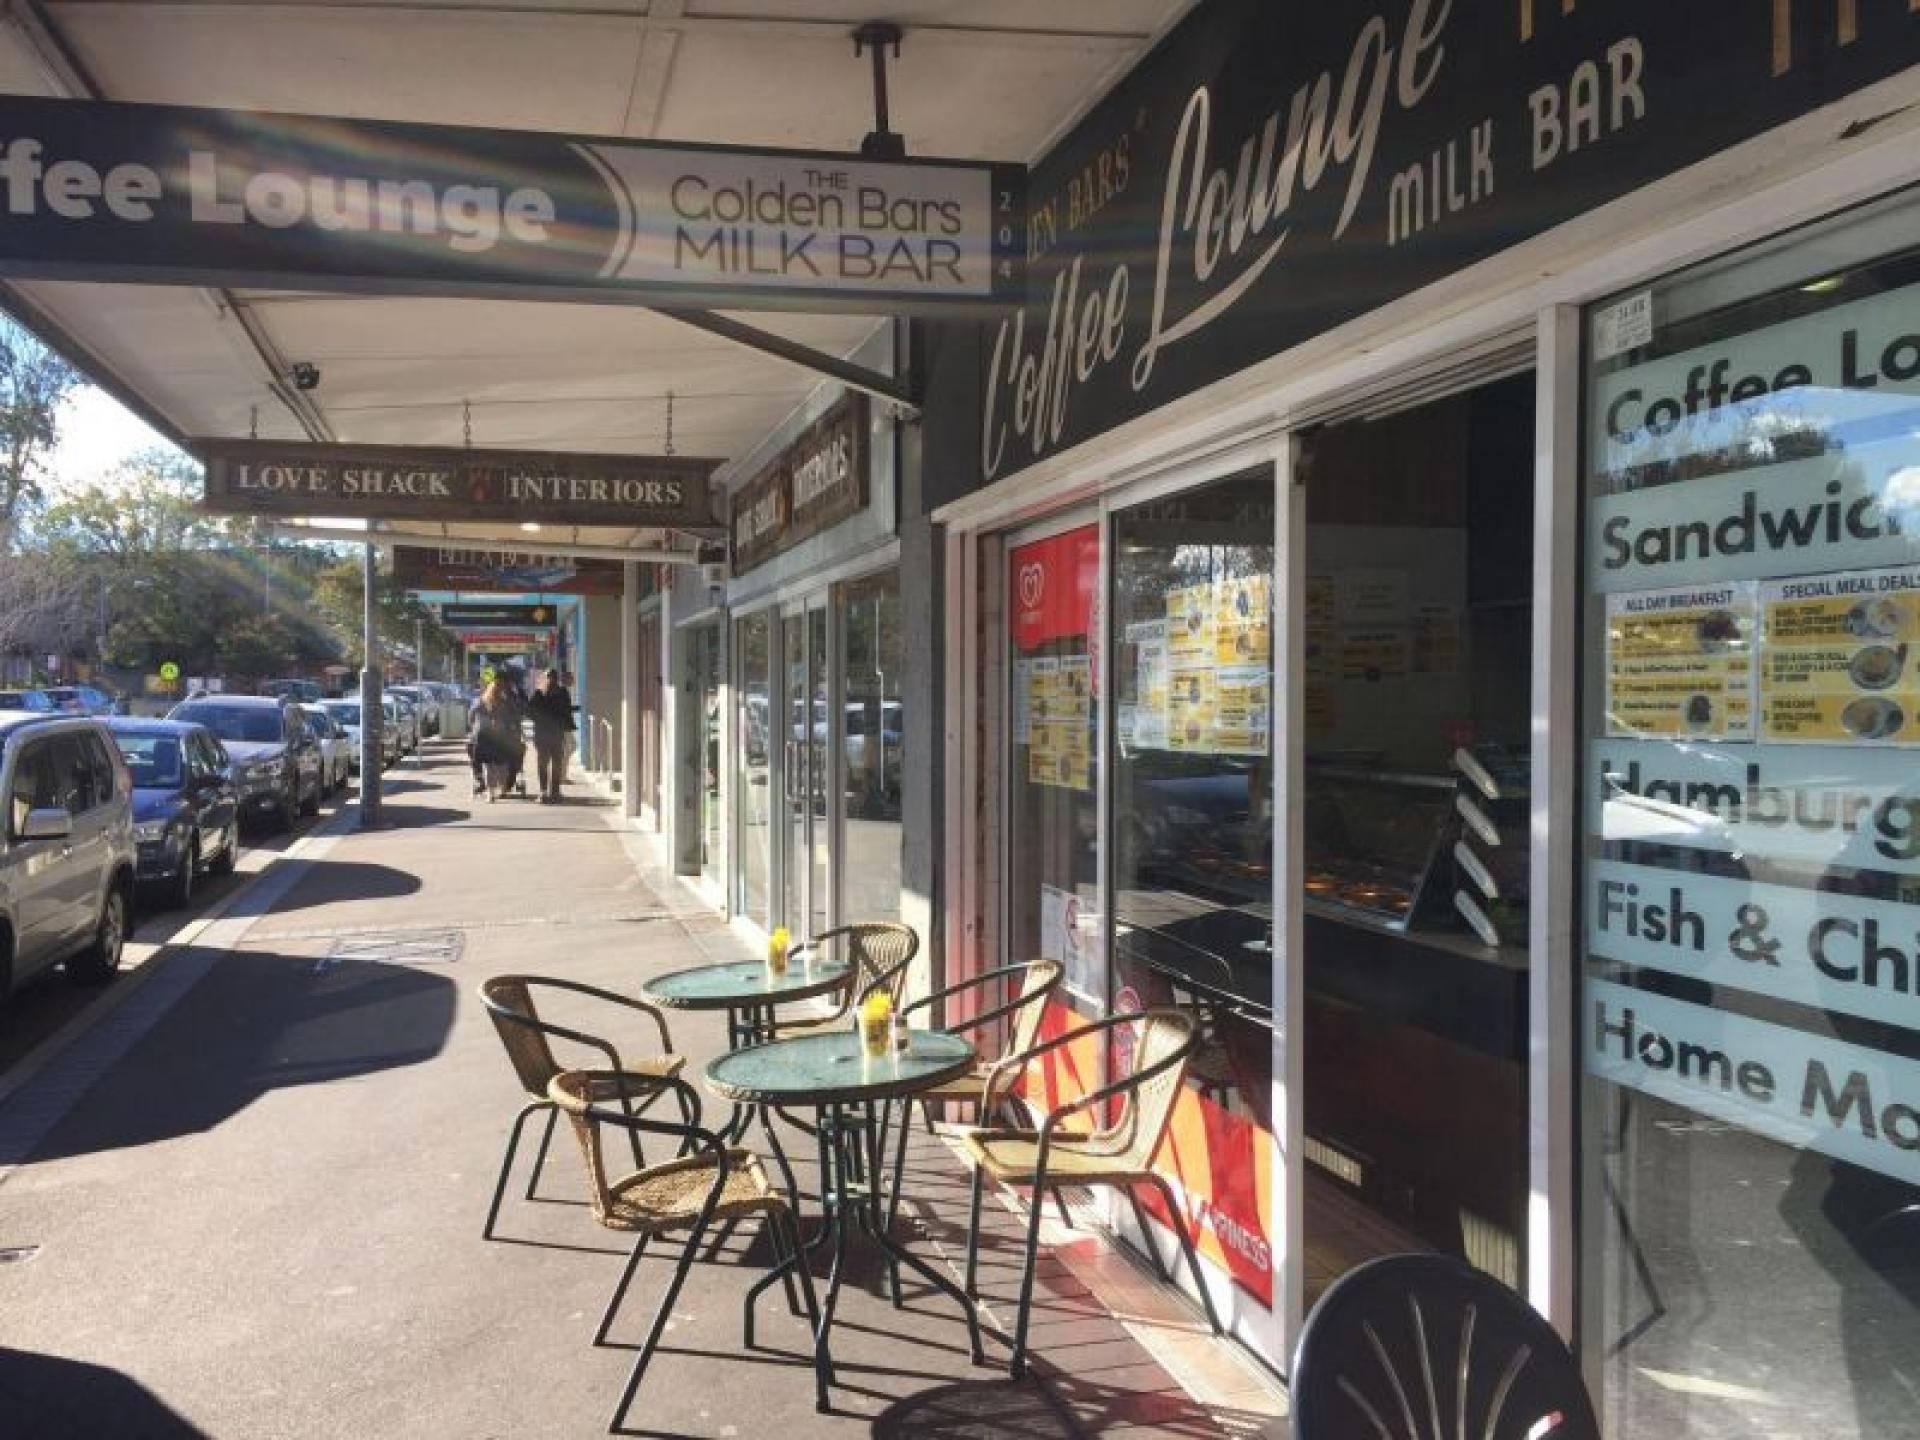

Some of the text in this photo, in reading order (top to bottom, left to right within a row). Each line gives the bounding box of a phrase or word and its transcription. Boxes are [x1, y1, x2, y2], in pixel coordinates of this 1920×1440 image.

[803, 170, 849, 190] THE
[1388, 119, 1494, 247] MILK
[1529, 36, 1645, 172] BAR
[0, 138, 556, 252] fee Lounge
[857, 188, 962, 234] Bars
[674, 225, 965, 284] MILK BAR
[984, 0, 1453, 481] Coffee Lounge
[239, 465, 682, 503] LOVE SHACK INTERIORS
[1603, 480, 1901, 569] Sandwic
[1598, 880, 1706, 951] Fish
[1728, 902, 1782, 967] &
[1595, 1000, 1776, 1101] Home
